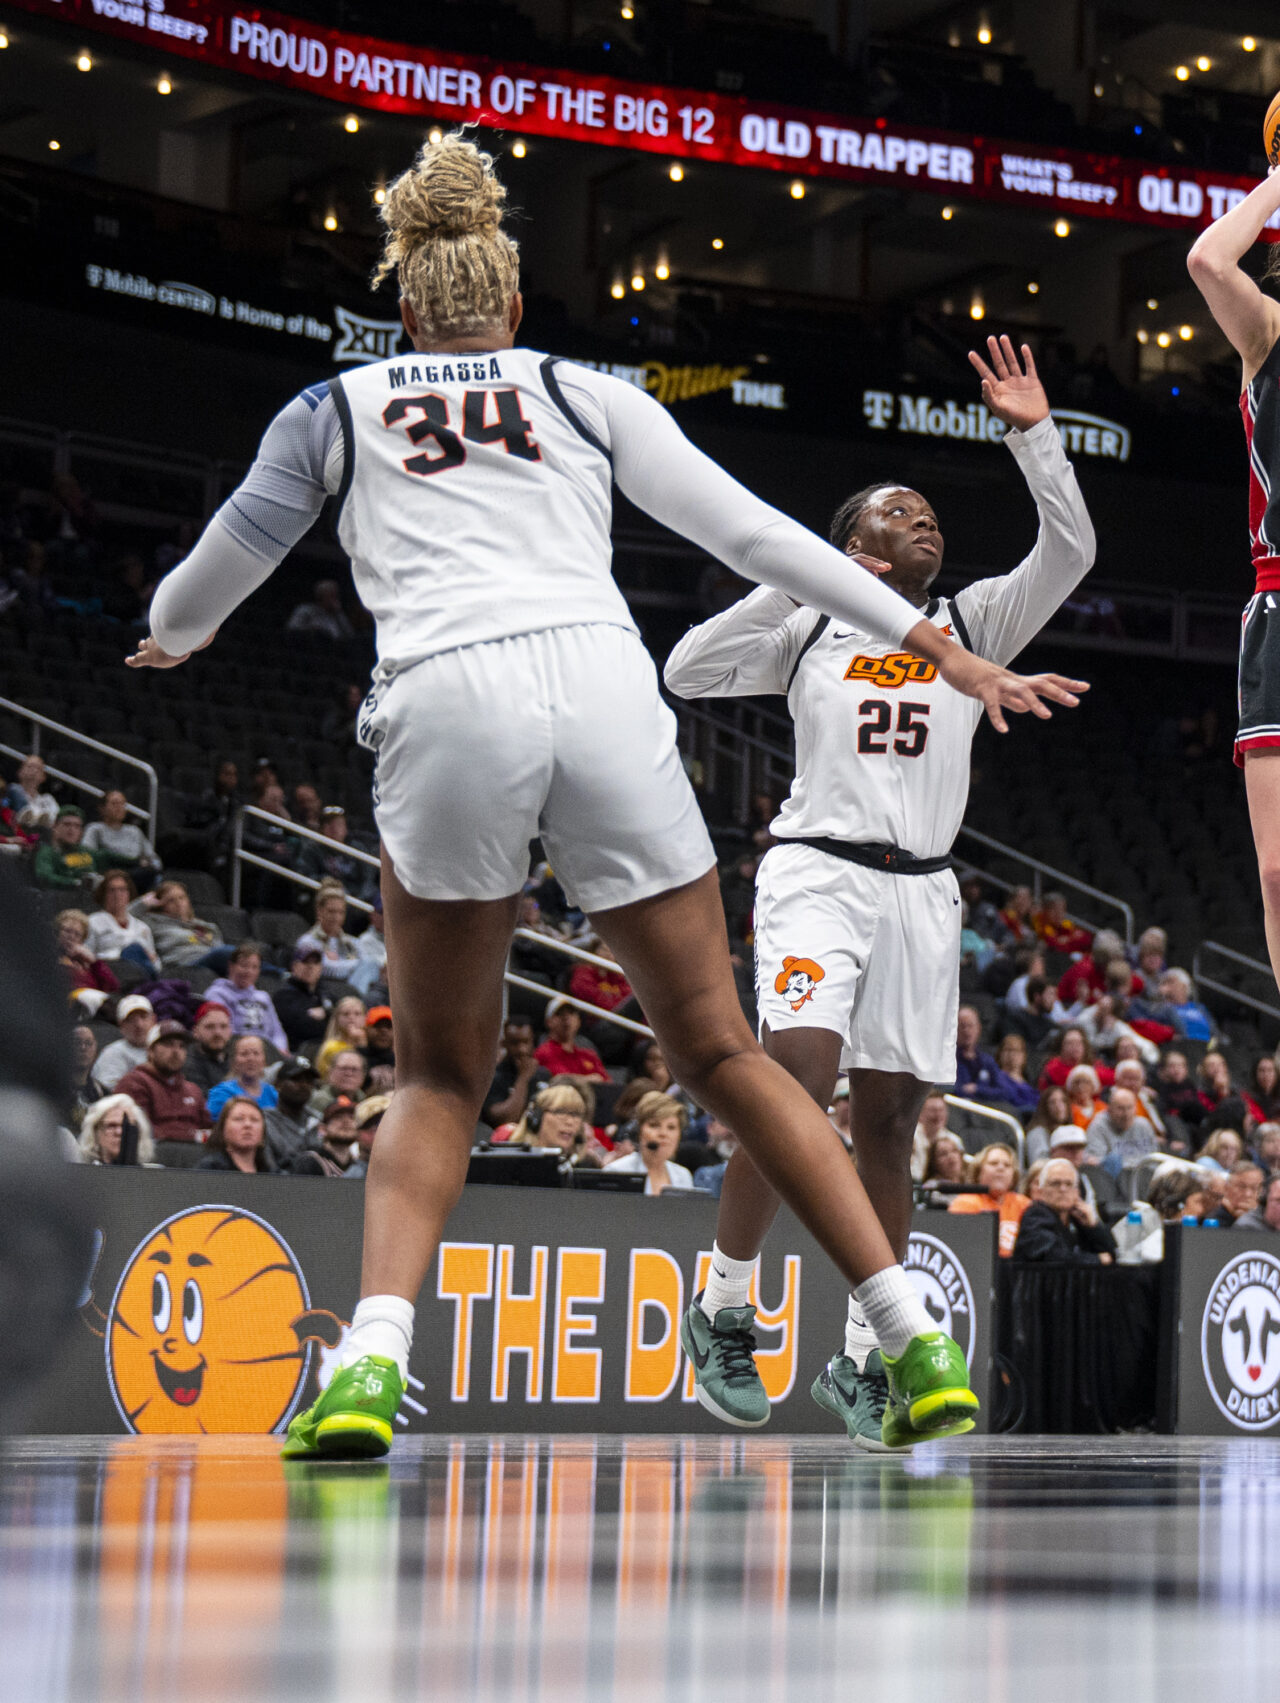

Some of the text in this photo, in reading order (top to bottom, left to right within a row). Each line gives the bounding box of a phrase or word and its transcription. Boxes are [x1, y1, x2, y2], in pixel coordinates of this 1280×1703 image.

[148, 11, 208, 44] BEEF?
[230, 17, 714, 144] PROUD PARTNER OF THE BIG 12
[740, 114, 975, 185] OLD TRAPPER
[1001, 154, 1073, 181] WHAT'S
[1001, 171, 1118, 205] YOUR BEEF?
[1138, 175, 1203, 218] OLD
[104, 267, 156, 301] Mobile
[157, 284, 215, 315] CENTER
[236, 302, 285, 332] Home
[286, 314, 303, 334] of
[305, 317, 333, 343] the
[388, 357, 502, 390] MAGASSA
[731, 380, 785, 409] TIME
[381, 389, 543, 477] 34
[898, 395, 1006, 444] Mobile
[843, 652, 940, 689] OSU
[857, 699, 931, 758] 25
[437, 1242, 606, 1402] THE
[1226, 1387, 1280, 1421] DAIRY
